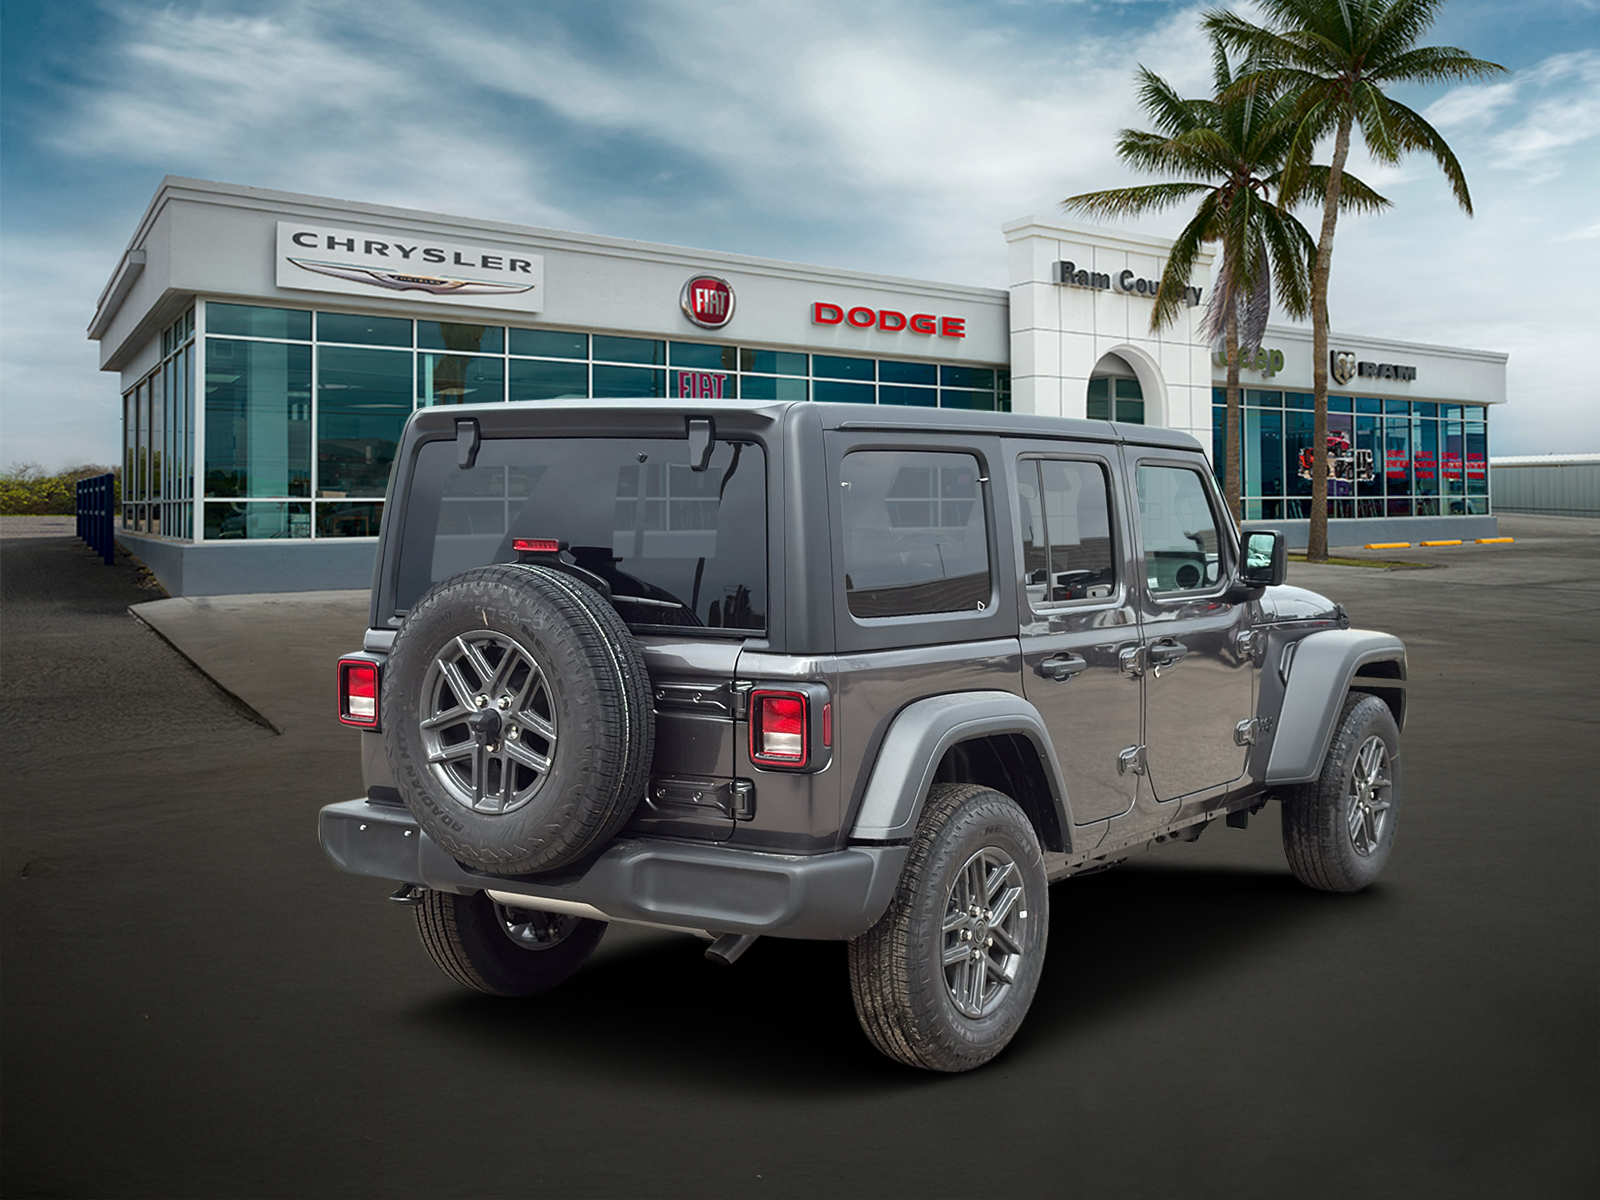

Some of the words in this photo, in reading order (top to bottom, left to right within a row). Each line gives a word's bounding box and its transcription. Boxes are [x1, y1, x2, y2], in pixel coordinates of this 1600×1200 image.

[292, 232, 532, 273] CHRYSLER
[1056, 260, 1110, 290] Ram
[1114, 269, 1203, 307] Coury
[695, 288, 727, 316] FIAT
[812, 301, 966, 338] DODGE
[678, 371, 727, 399] FIAT
[1358, 361, 1417, 381] RAM
